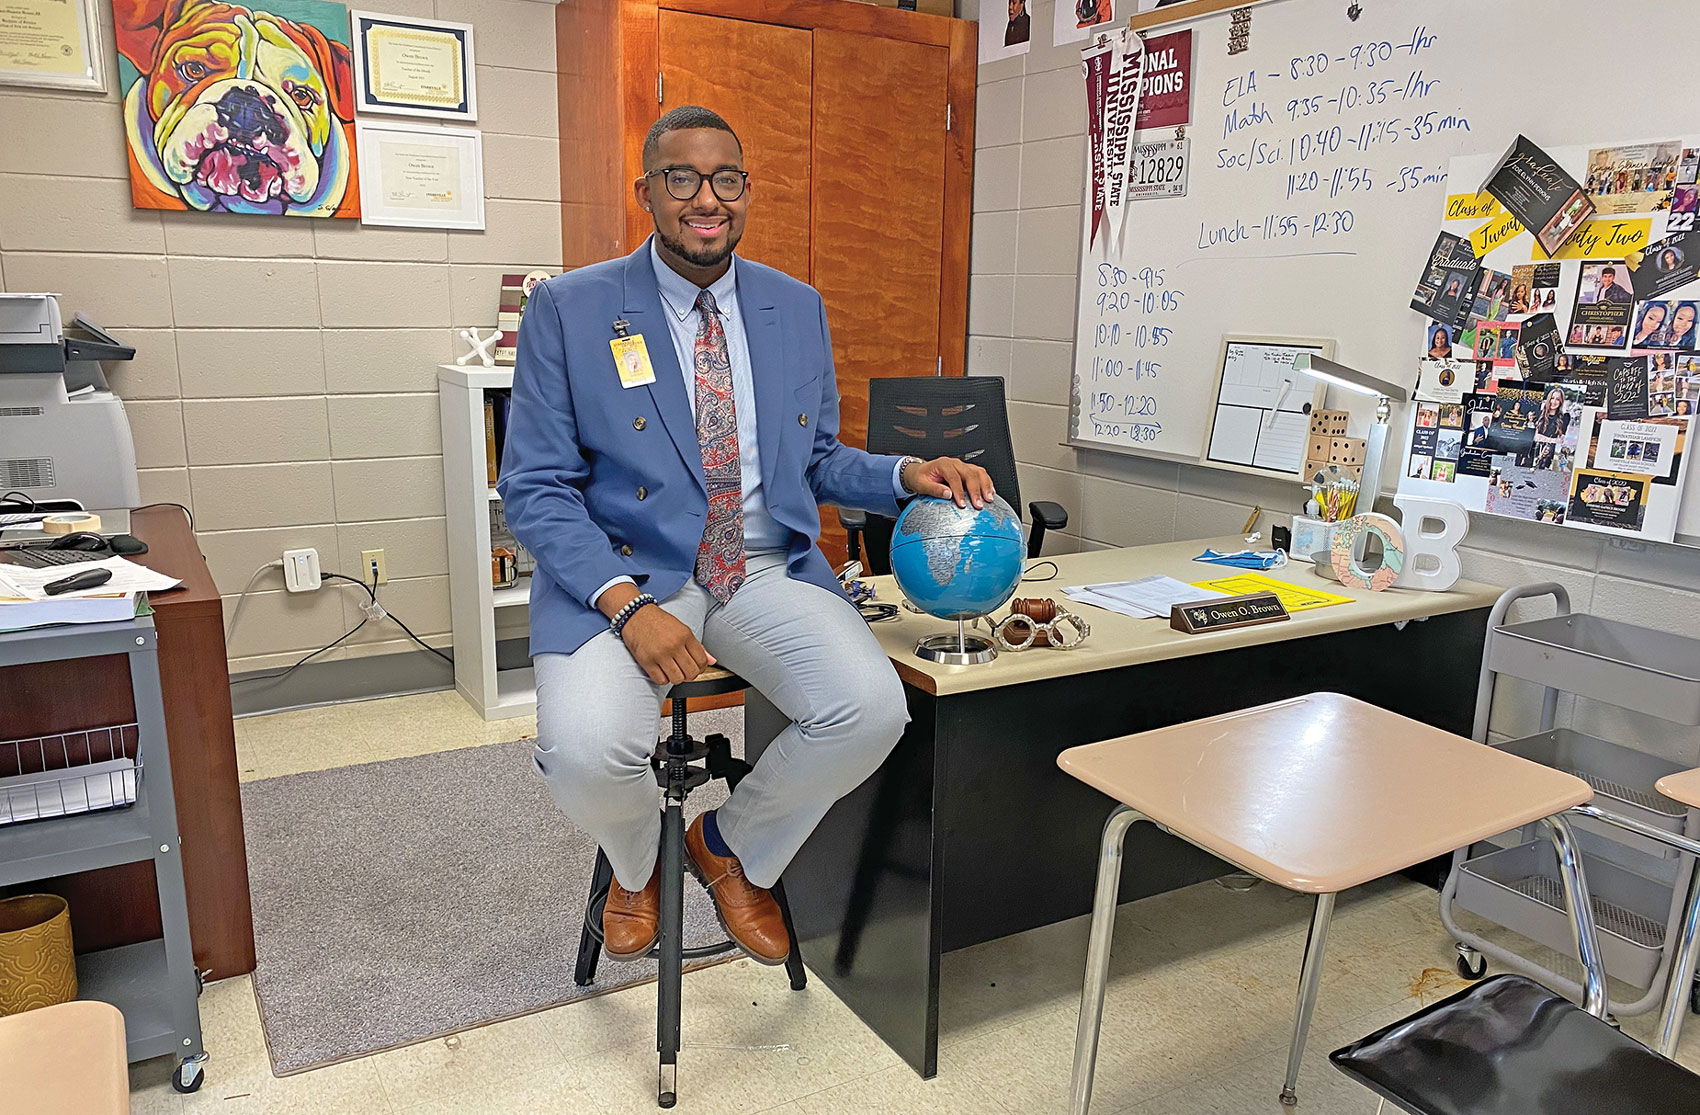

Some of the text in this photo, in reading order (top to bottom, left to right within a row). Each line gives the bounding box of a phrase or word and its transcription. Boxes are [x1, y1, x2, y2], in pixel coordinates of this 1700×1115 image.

[1223, 70, 1257, 107] ELA
[1109, 47, 1143, 207] MISSISSIPPI STATE
[1222, 102, 1273, 140] Math
[1139, 155, 1184, 184] 12829
[1448, 198, 1479, 217] Class
[1480, 198, 1496, 216] of
[1479, 216, 1523, 250] Twent
[1667, 212, 1696, 231] 22
[1198, 219, 1249, 249] Lunch
[1605, 223, 1644, 247] Two
[1645, 244, 1662, 257] Class
[1671, 232, 1686, 244] 2022
[1580, 309, 1625, 318] CHRISTOPHER
[1650, 333, 1680, 343] GRAD
[1621, 423, 1636, 432] CLASS
[1644, 425, 1658, 433] 2022
[1210, 602, 1280, 620] Owen O. Brown
